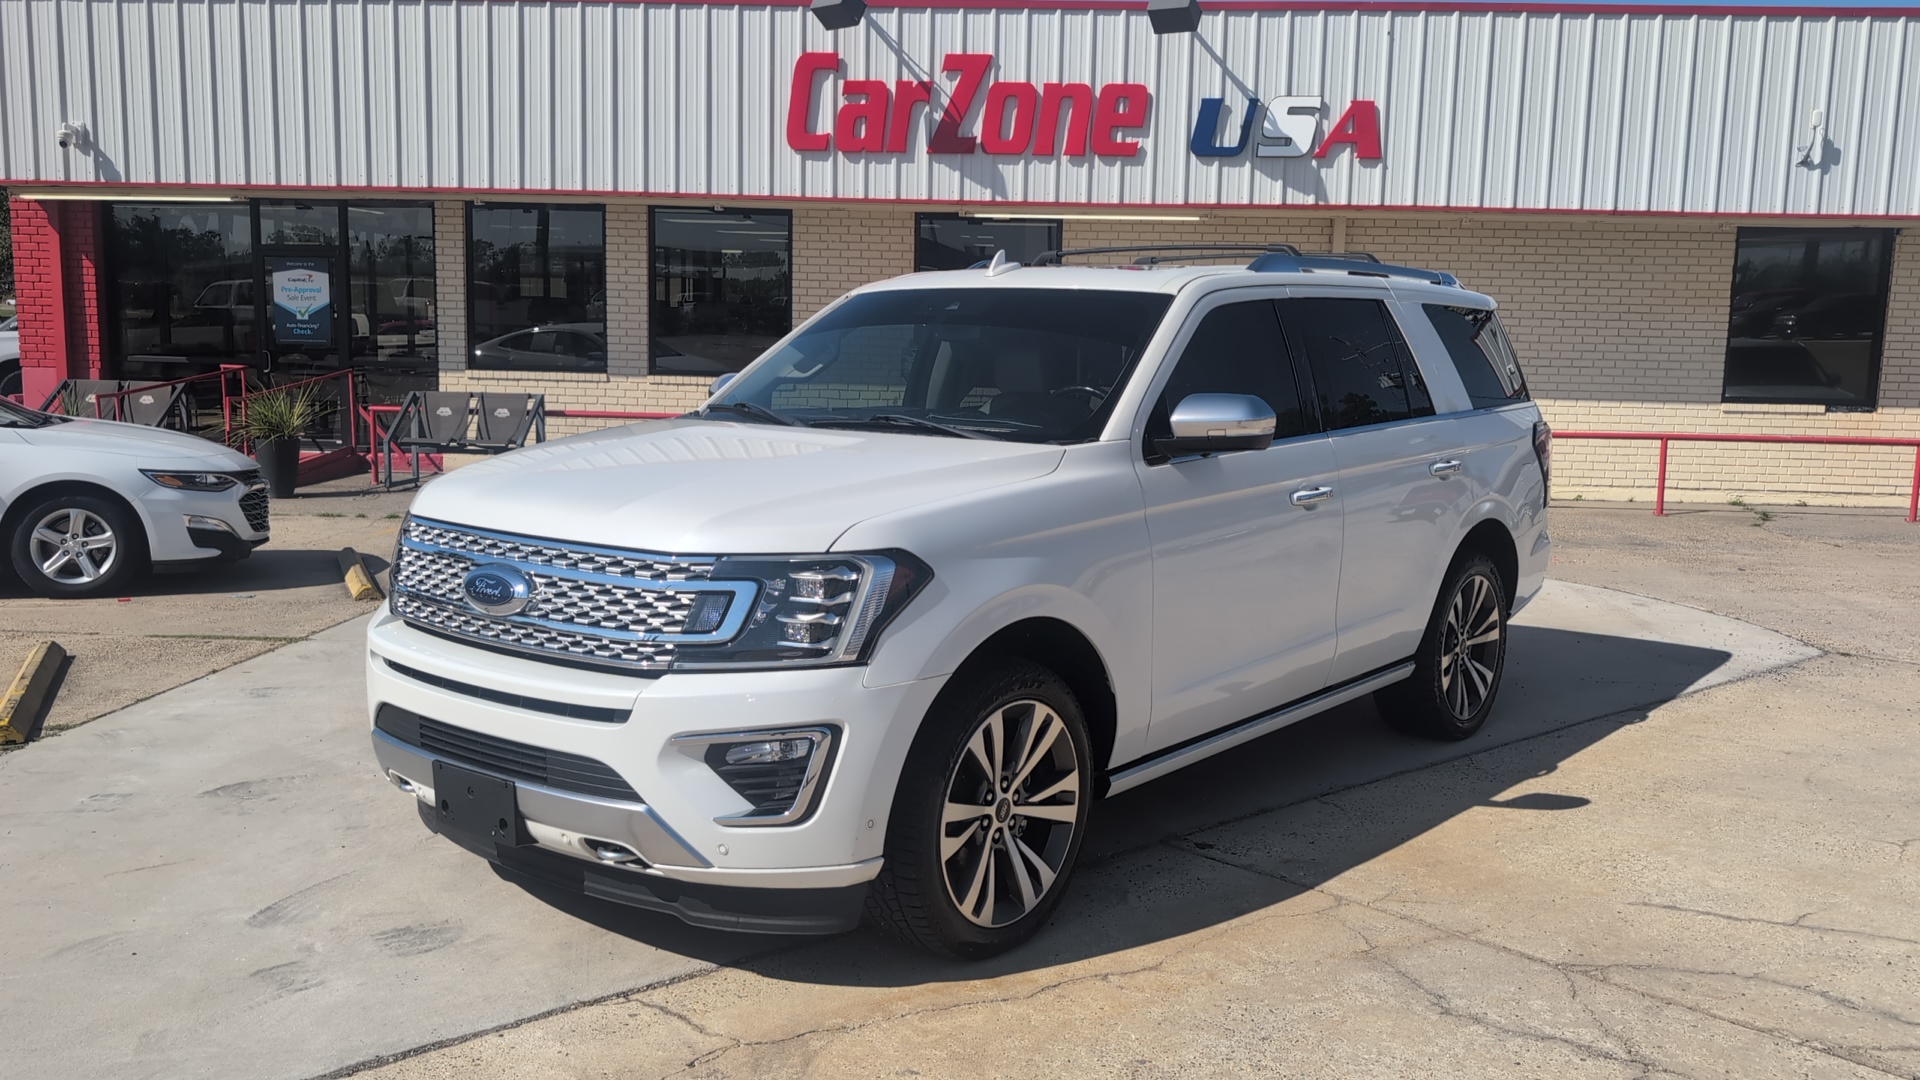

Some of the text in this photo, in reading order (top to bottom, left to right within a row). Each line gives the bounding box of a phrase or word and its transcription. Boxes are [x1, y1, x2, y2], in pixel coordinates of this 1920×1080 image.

[786, 52, 1382, 160] CarZone USA
[281, 286, 322, 294] Pre-Approval
[469, 577, 502, 598] Ford
